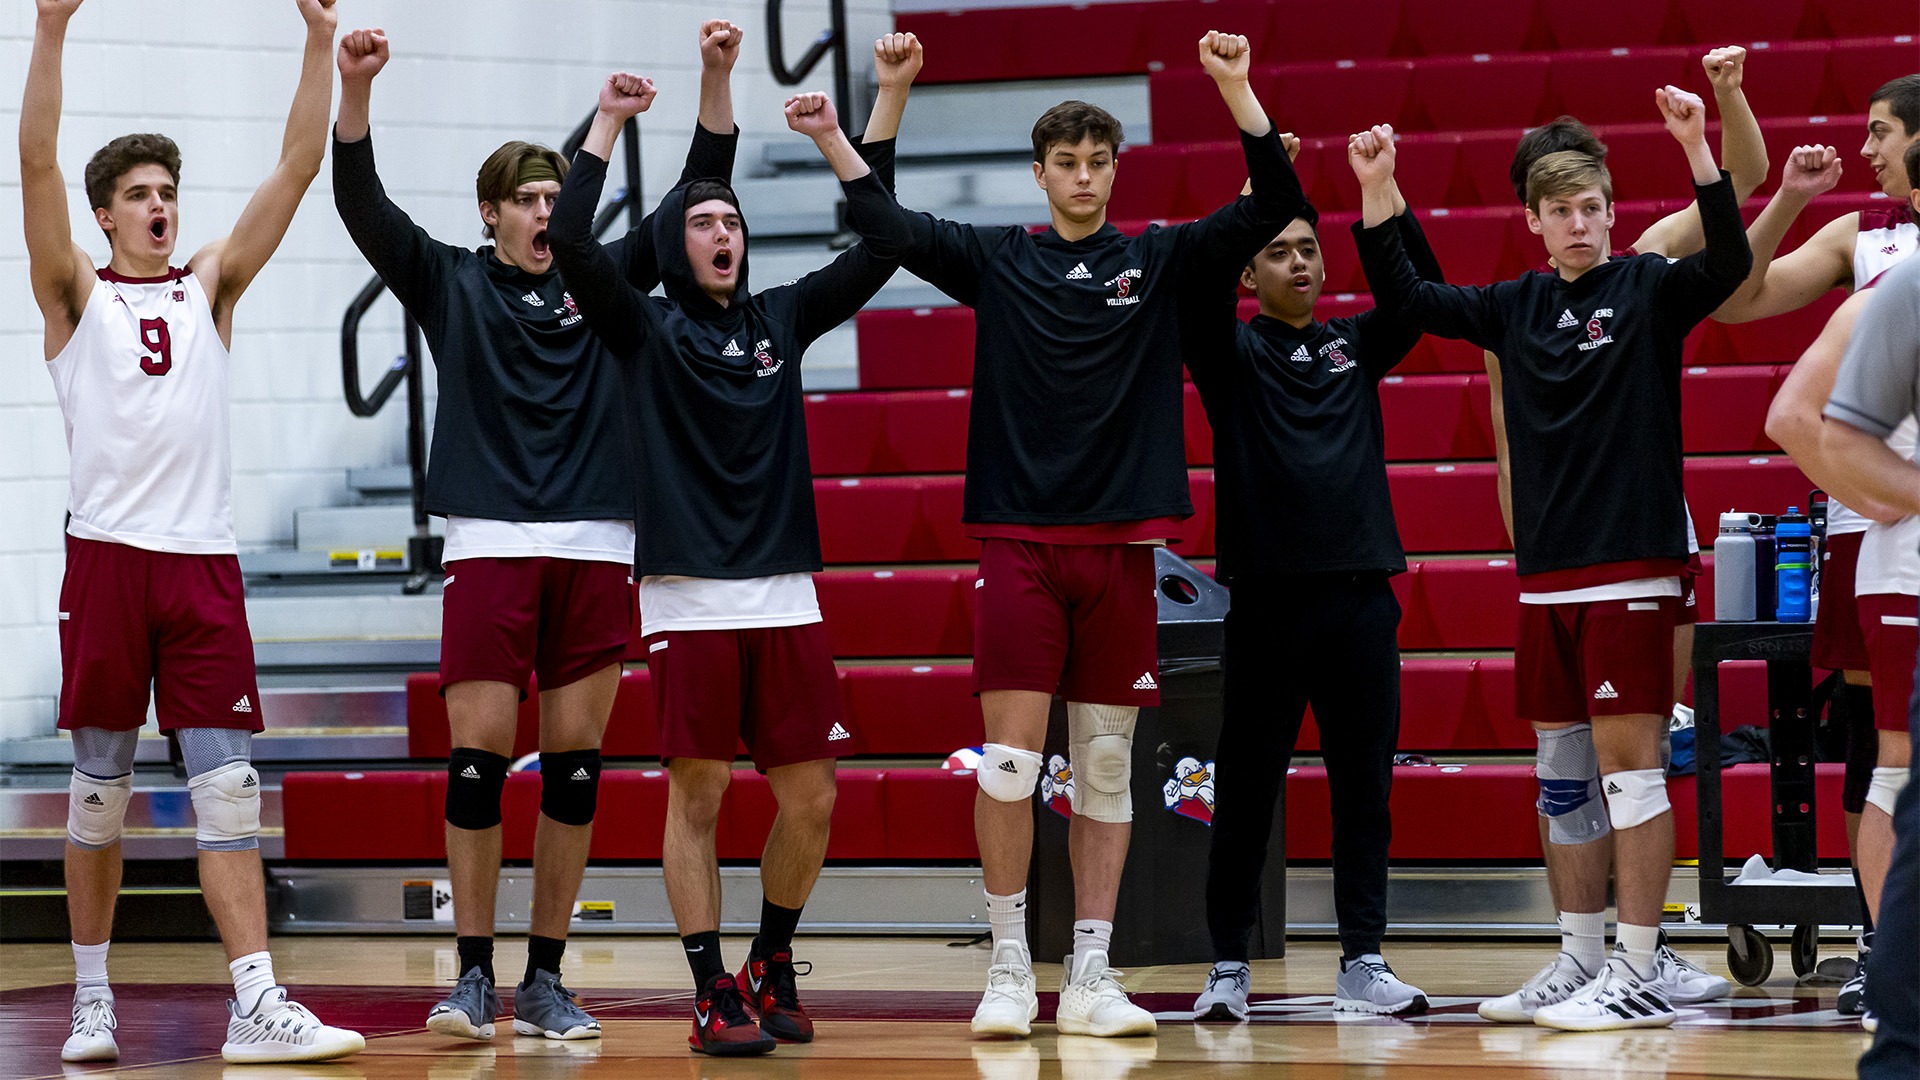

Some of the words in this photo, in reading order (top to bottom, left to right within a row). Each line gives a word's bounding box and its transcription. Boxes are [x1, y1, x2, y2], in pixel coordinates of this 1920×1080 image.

[1106, 295, 1140, 306] VOLLEYBALL
[139, 316, 172, 376] 9
[756, 359, 785, 377] OLLEYBALL
